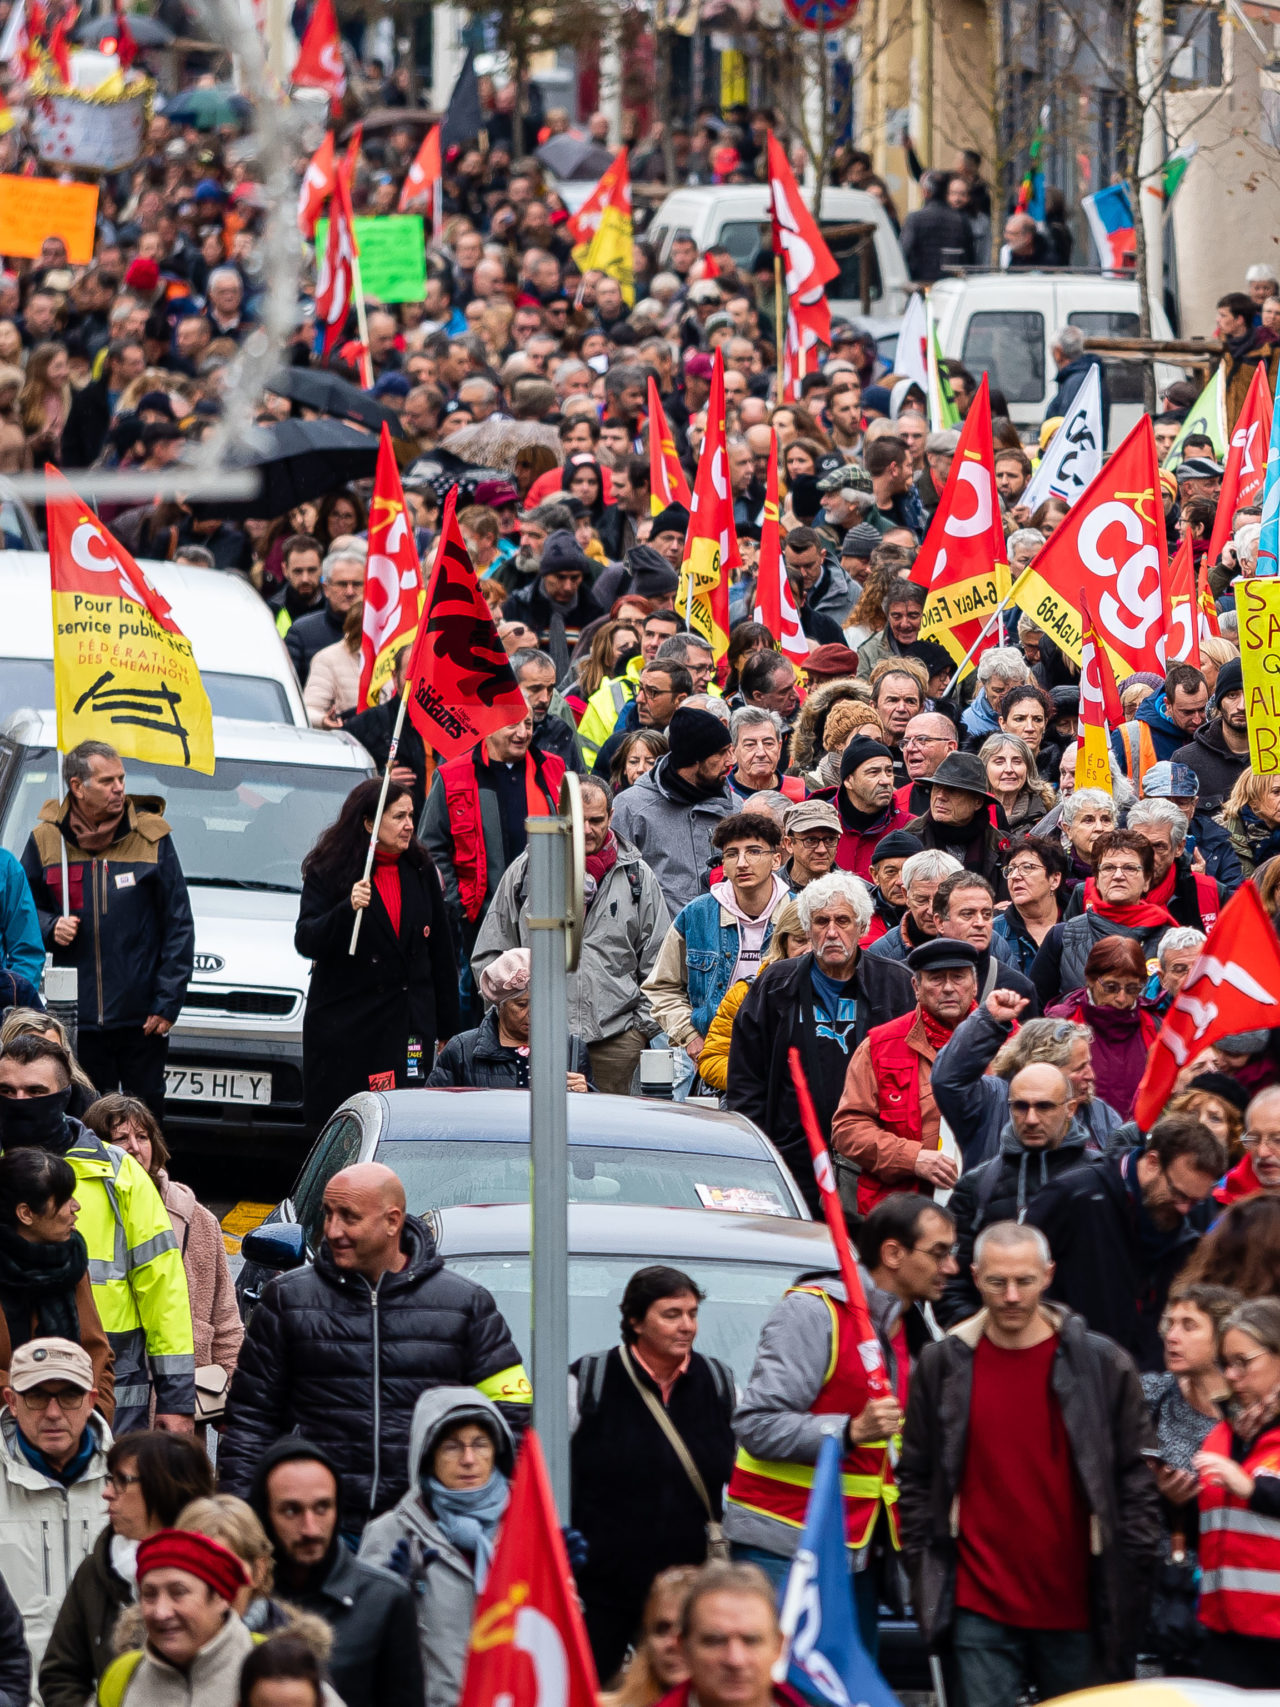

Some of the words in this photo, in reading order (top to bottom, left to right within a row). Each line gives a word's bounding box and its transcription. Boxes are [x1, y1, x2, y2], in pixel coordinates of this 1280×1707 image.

[74, 594, 112, 613] Pour
[119, 596, 134, 614] la
[57, 616, 112, 635] service
[78, 653, 103, 665] DES
[109, 656, 190, 686] CHEMINOTS
[414, 677, 468, 740] Solidaires
